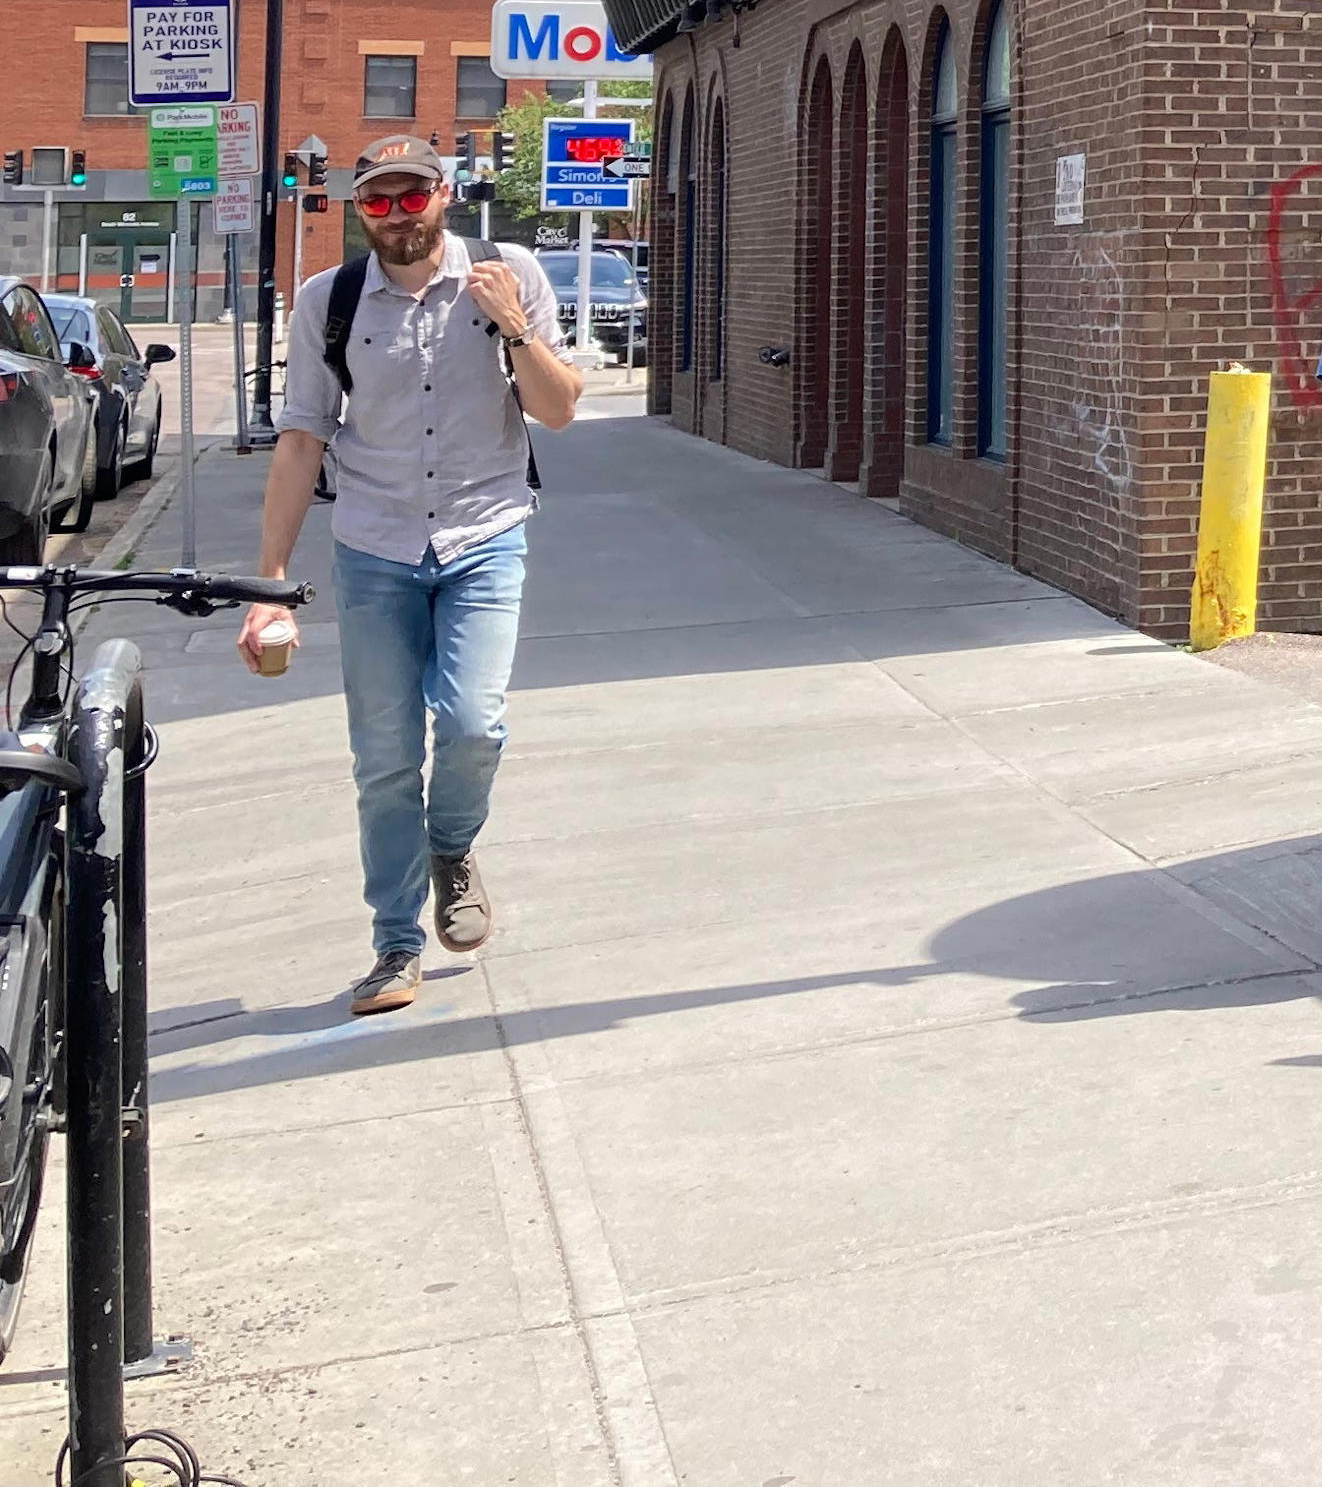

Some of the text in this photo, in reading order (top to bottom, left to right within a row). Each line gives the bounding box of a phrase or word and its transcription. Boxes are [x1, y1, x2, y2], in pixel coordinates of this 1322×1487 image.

[147, 11, 214, 23] PAY FOR
[144, 24, 218, 37] PARKING
[509, 13, 652, 62] Mob
[142, 38, 223, 51] AT KIOSK
[221, 109, 238, 120] NO
[624, 165, 644, 173] ONE
[228, 183, 239, 192] NO
[216, 195, 249, 205] PARKING
[572, 191, 603, 205] Deli
[122, 213, 136, 222] 82
[535, 235, 569, 244] Market
